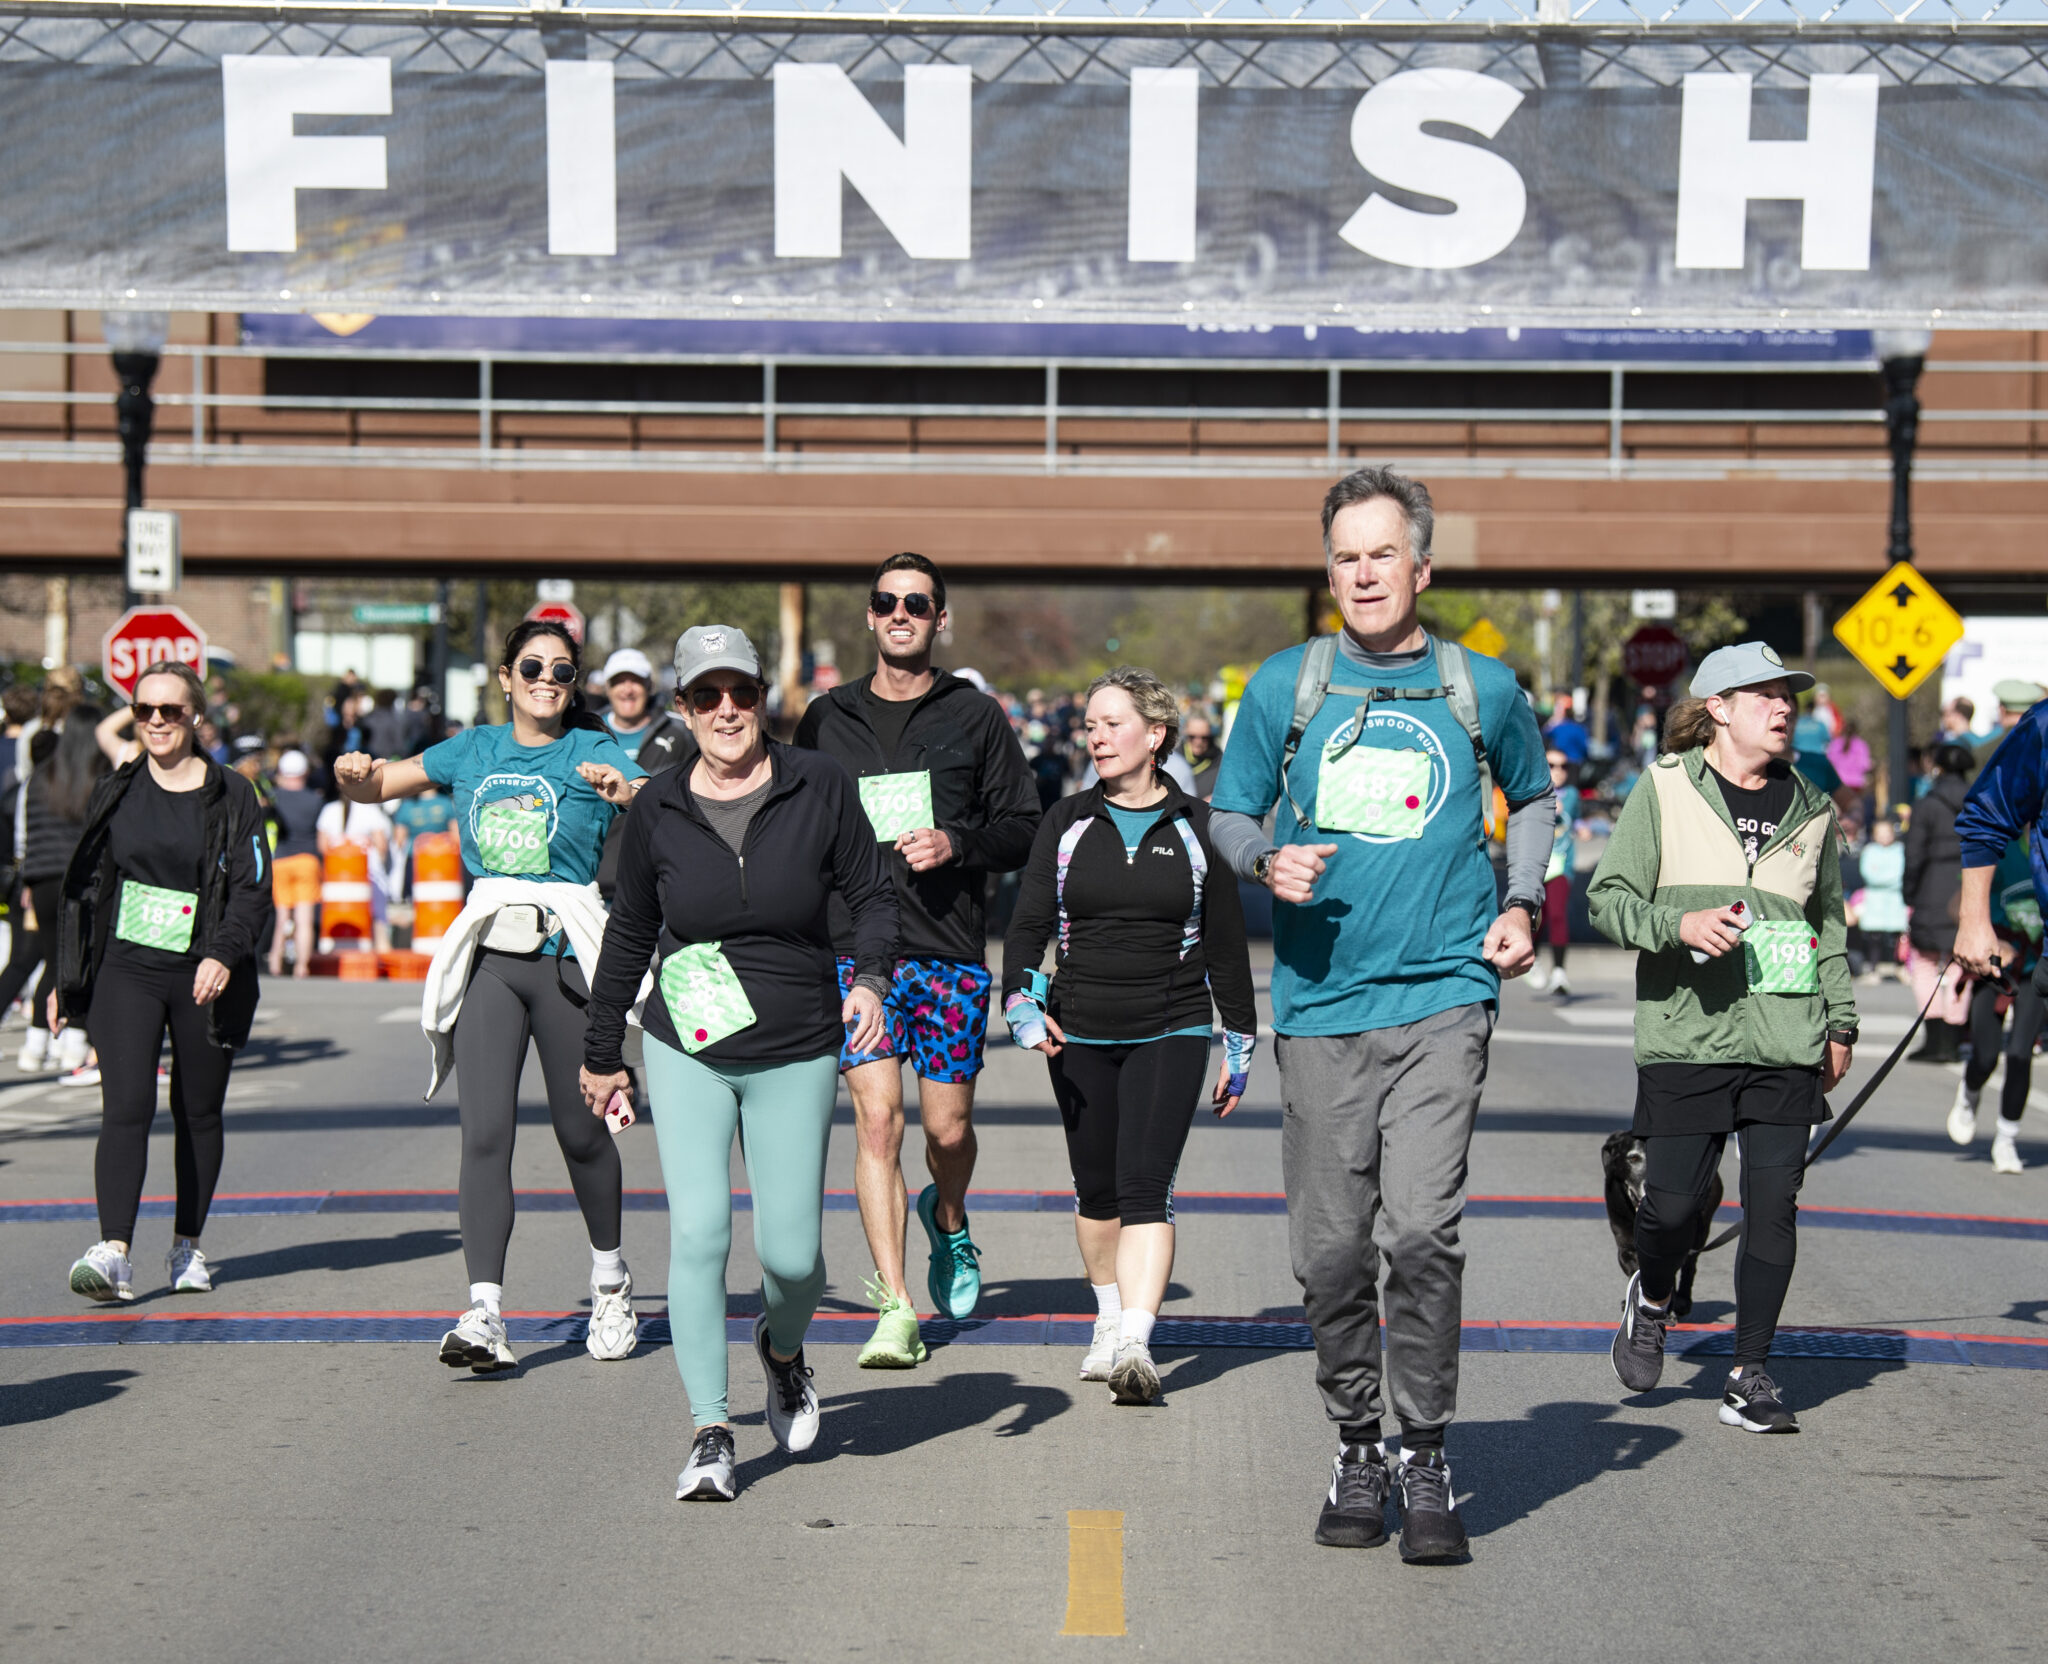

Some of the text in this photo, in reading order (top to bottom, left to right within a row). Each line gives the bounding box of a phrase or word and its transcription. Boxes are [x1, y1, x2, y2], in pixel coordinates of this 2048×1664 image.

[221, 54, 1880, 272] FINISH
[112, 636, 199, 680] STOP
[536, 784, 551, 803] RUN
[1346, 773, 1411, 802] 487
[866, 792, 924, 816] 1705
[1736, 817, 1759, 833] SO
[484, 827, 541, 850] 1706
[1151, 846, 1175, 857] FILA
[141, 904, 181, 927] 187
[1769, 942, 1812, 966] 198
